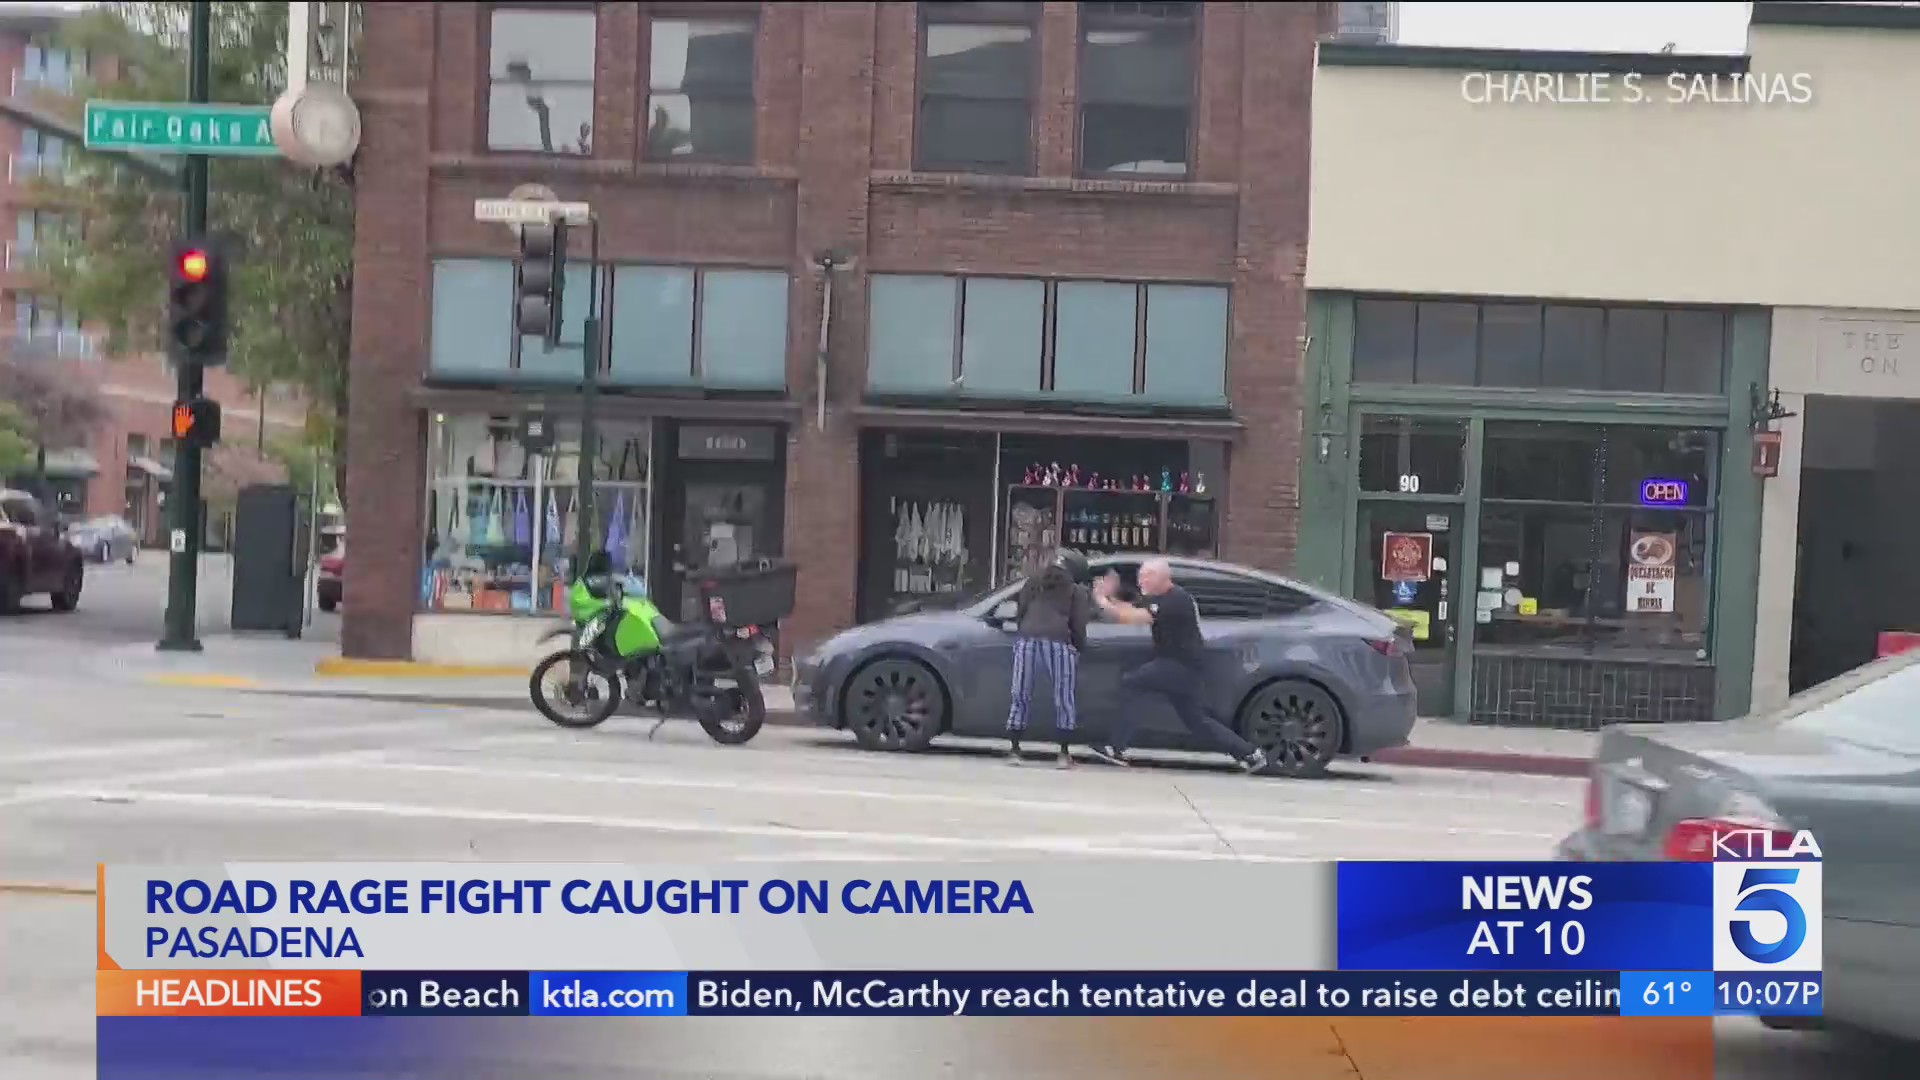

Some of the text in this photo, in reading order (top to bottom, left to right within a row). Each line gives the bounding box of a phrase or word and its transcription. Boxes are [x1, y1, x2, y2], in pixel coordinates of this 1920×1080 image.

[93, 111, 153, 140] Fair
[166, 114, 242, 143] Oaks
[1400, 475, 1420, 492] 90
[1645, 483, 1684, 500] OPEN
